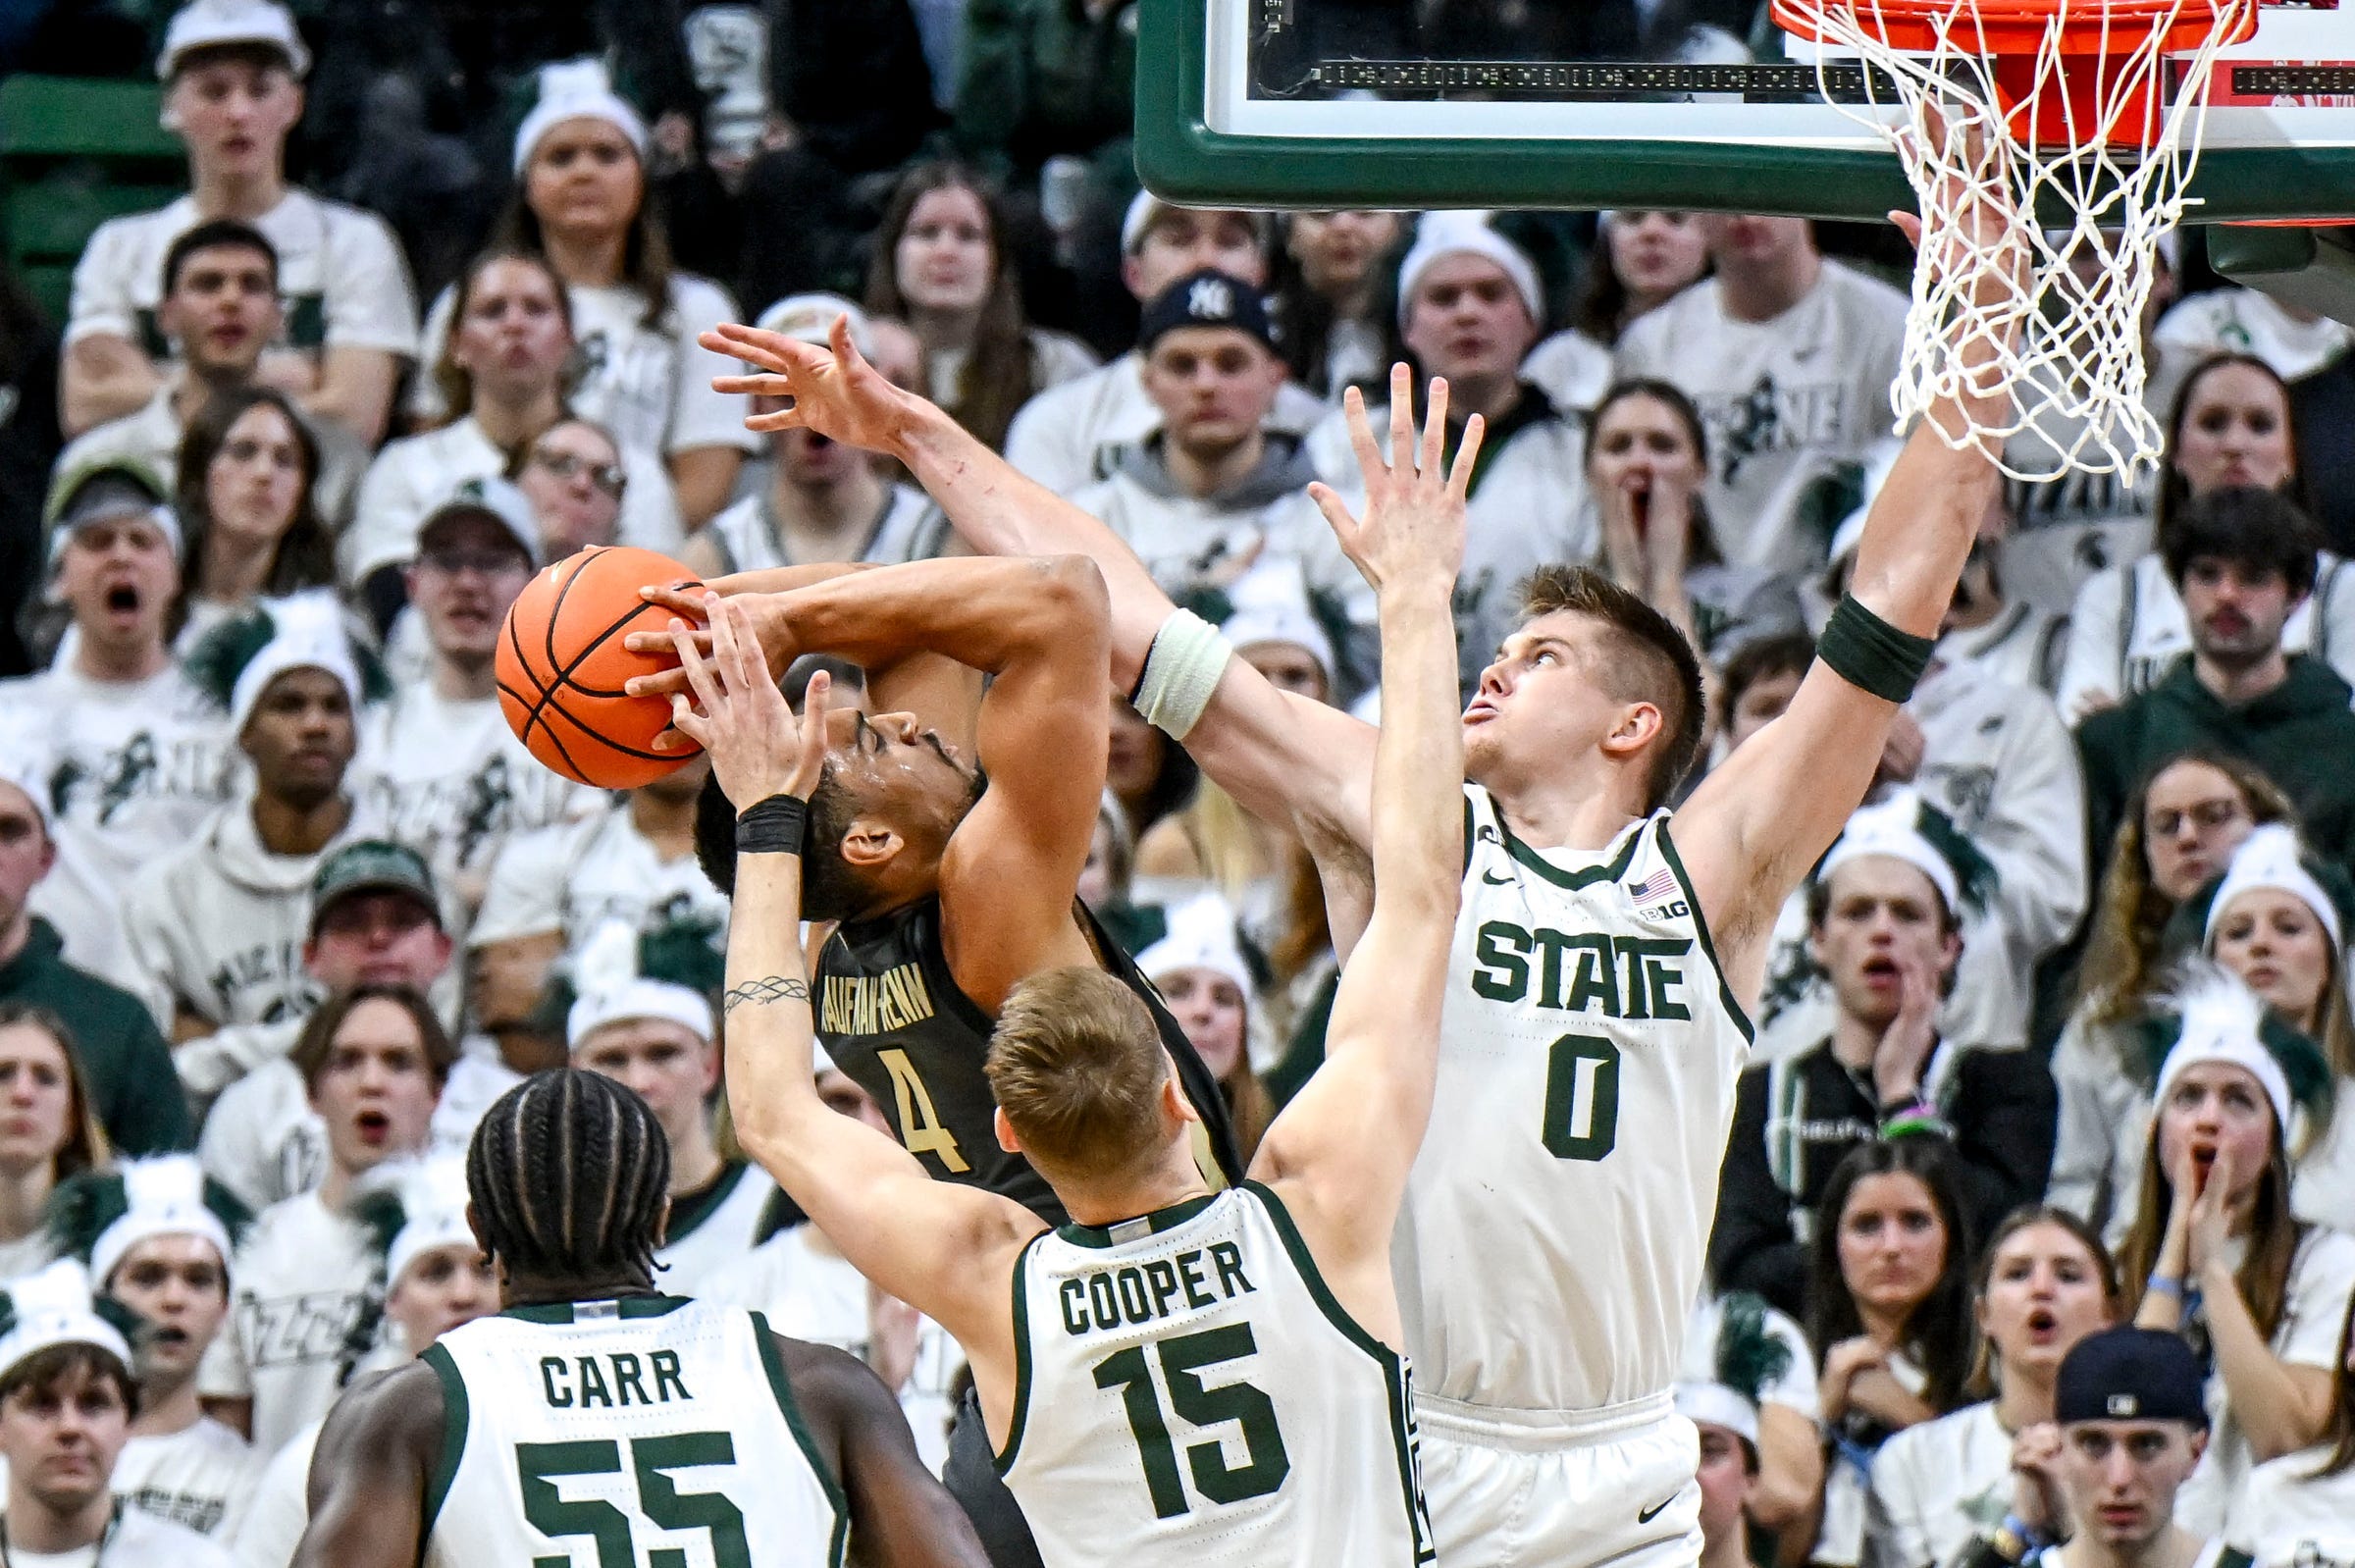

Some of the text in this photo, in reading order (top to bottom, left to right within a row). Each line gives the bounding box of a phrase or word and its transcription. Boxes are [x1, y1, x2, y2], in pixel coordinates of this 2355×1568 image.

[1472, 920, 1694, 1021] STATE
[876, 1048, 970, 1173] 4
[1542, 1033, 1621, 1162] 0
[1060, 1241, 1257, 1335] COOPER
[540, 1349, 694, 1408] CARR
[1092, 1321, 1290, 1519] 15
[514, 1431, 754, 1568] 55
